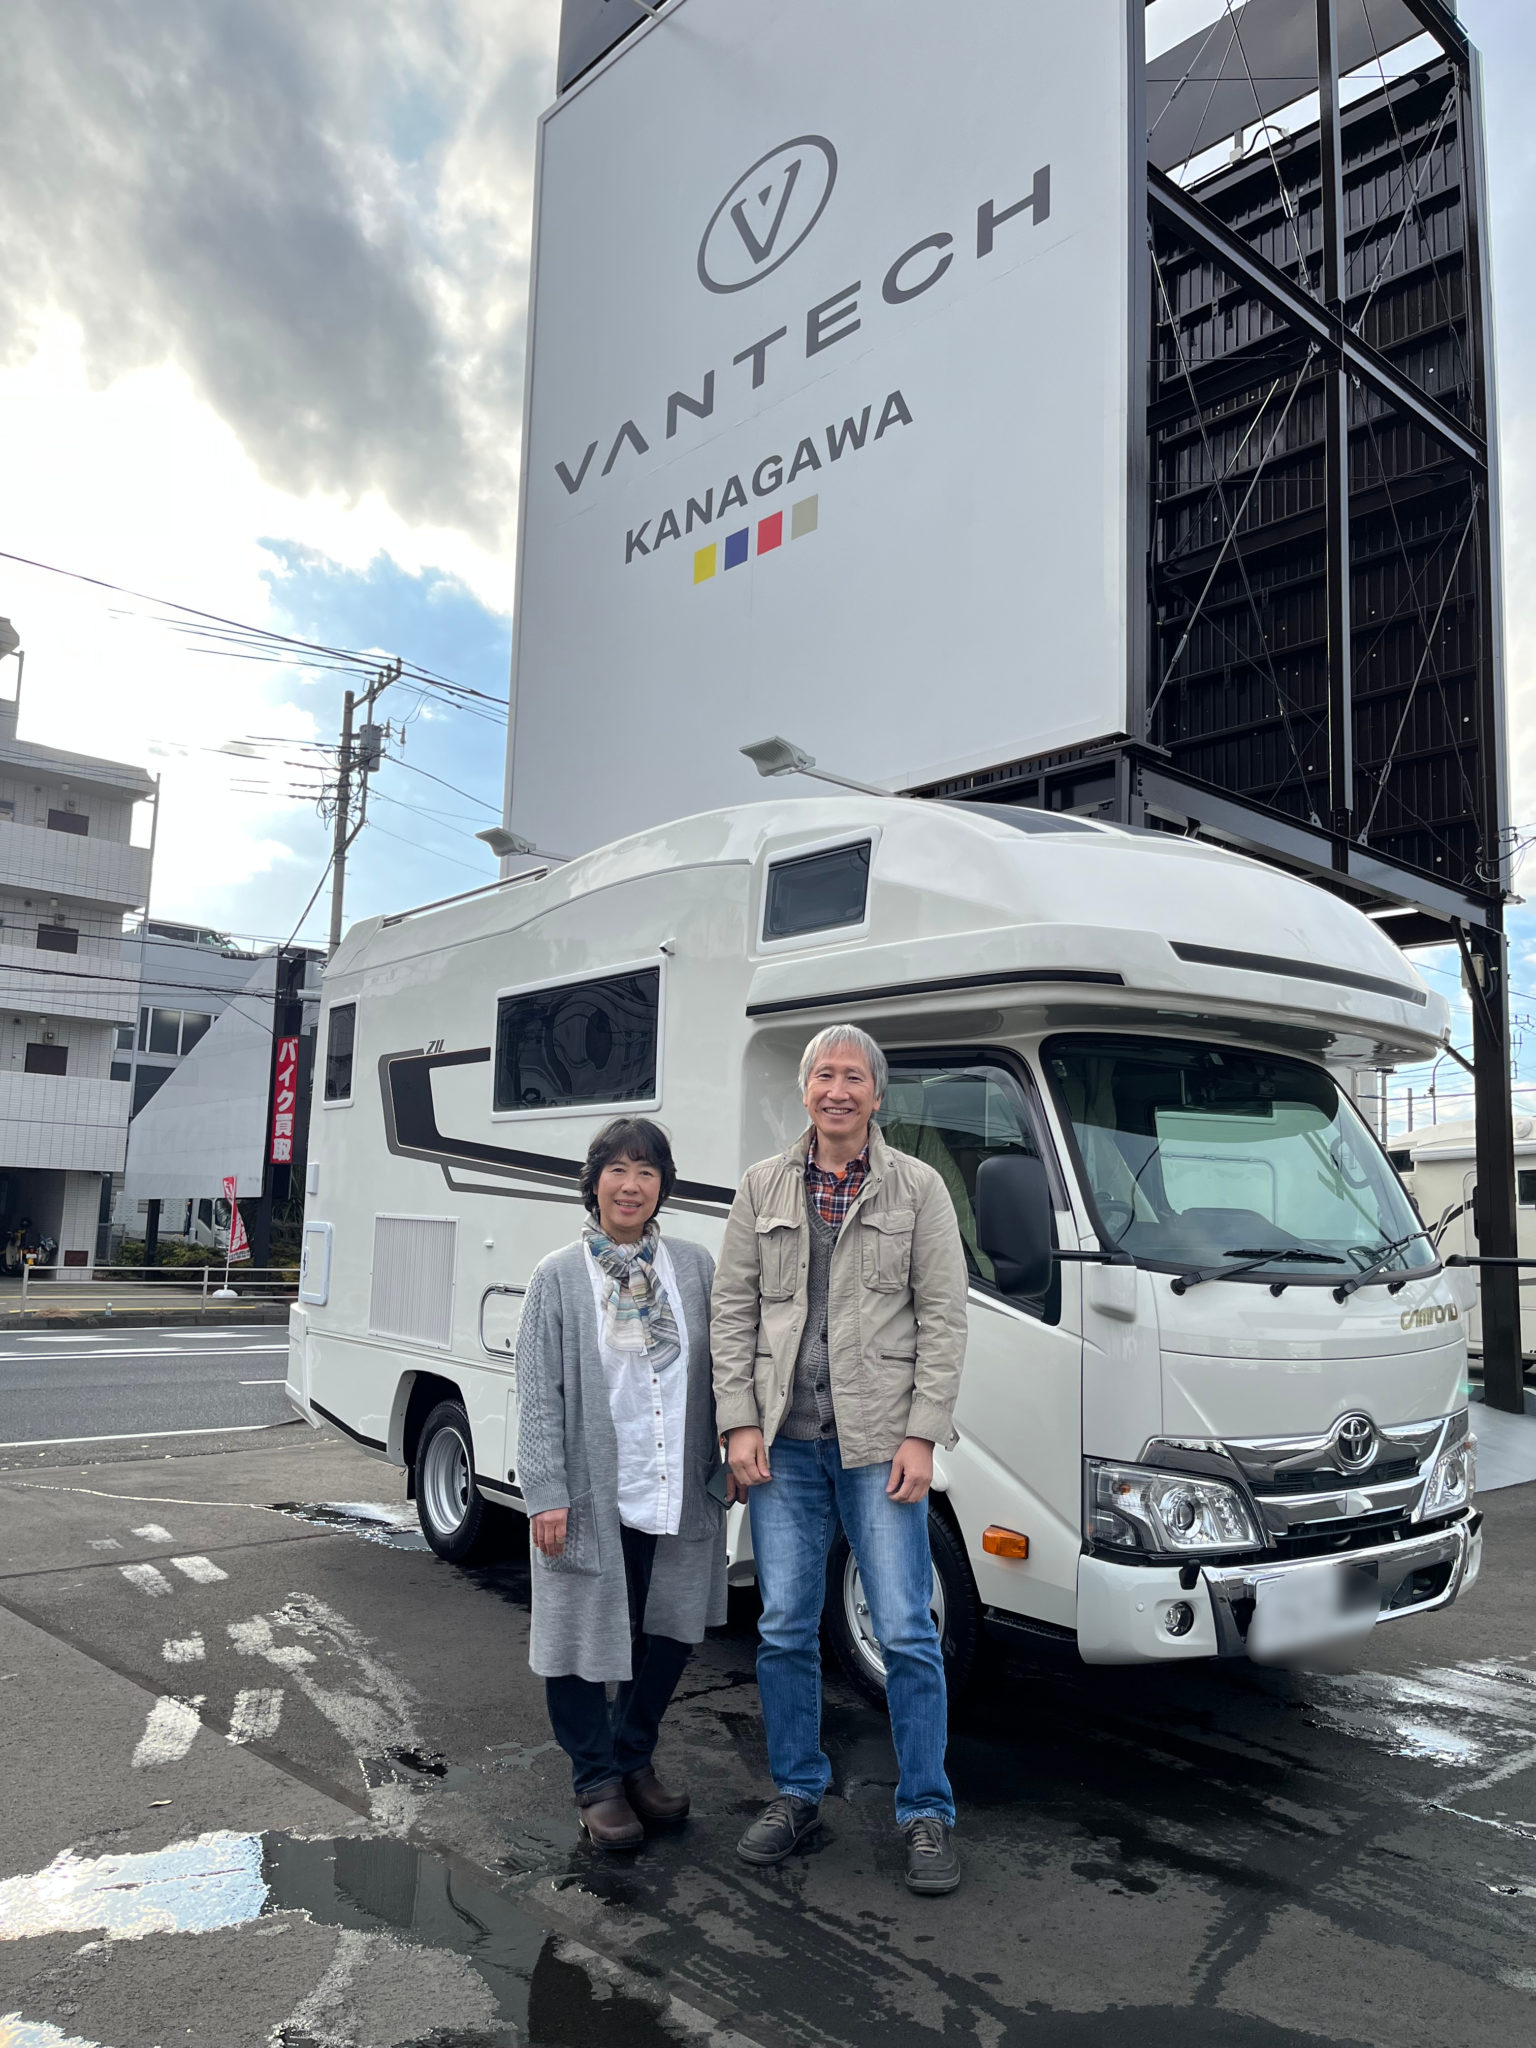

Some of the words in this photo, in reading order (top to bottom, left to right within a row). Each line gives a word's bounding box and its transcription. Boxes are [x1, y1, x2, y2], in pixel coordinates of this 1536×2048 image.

[553, 163, 1051, 495] VANTECH
[623, 388, 914, 565] KANAGAWA
[272, 1038, 299, 1161] バイク買取
[425, 1038, 446, 1055] ZIL
